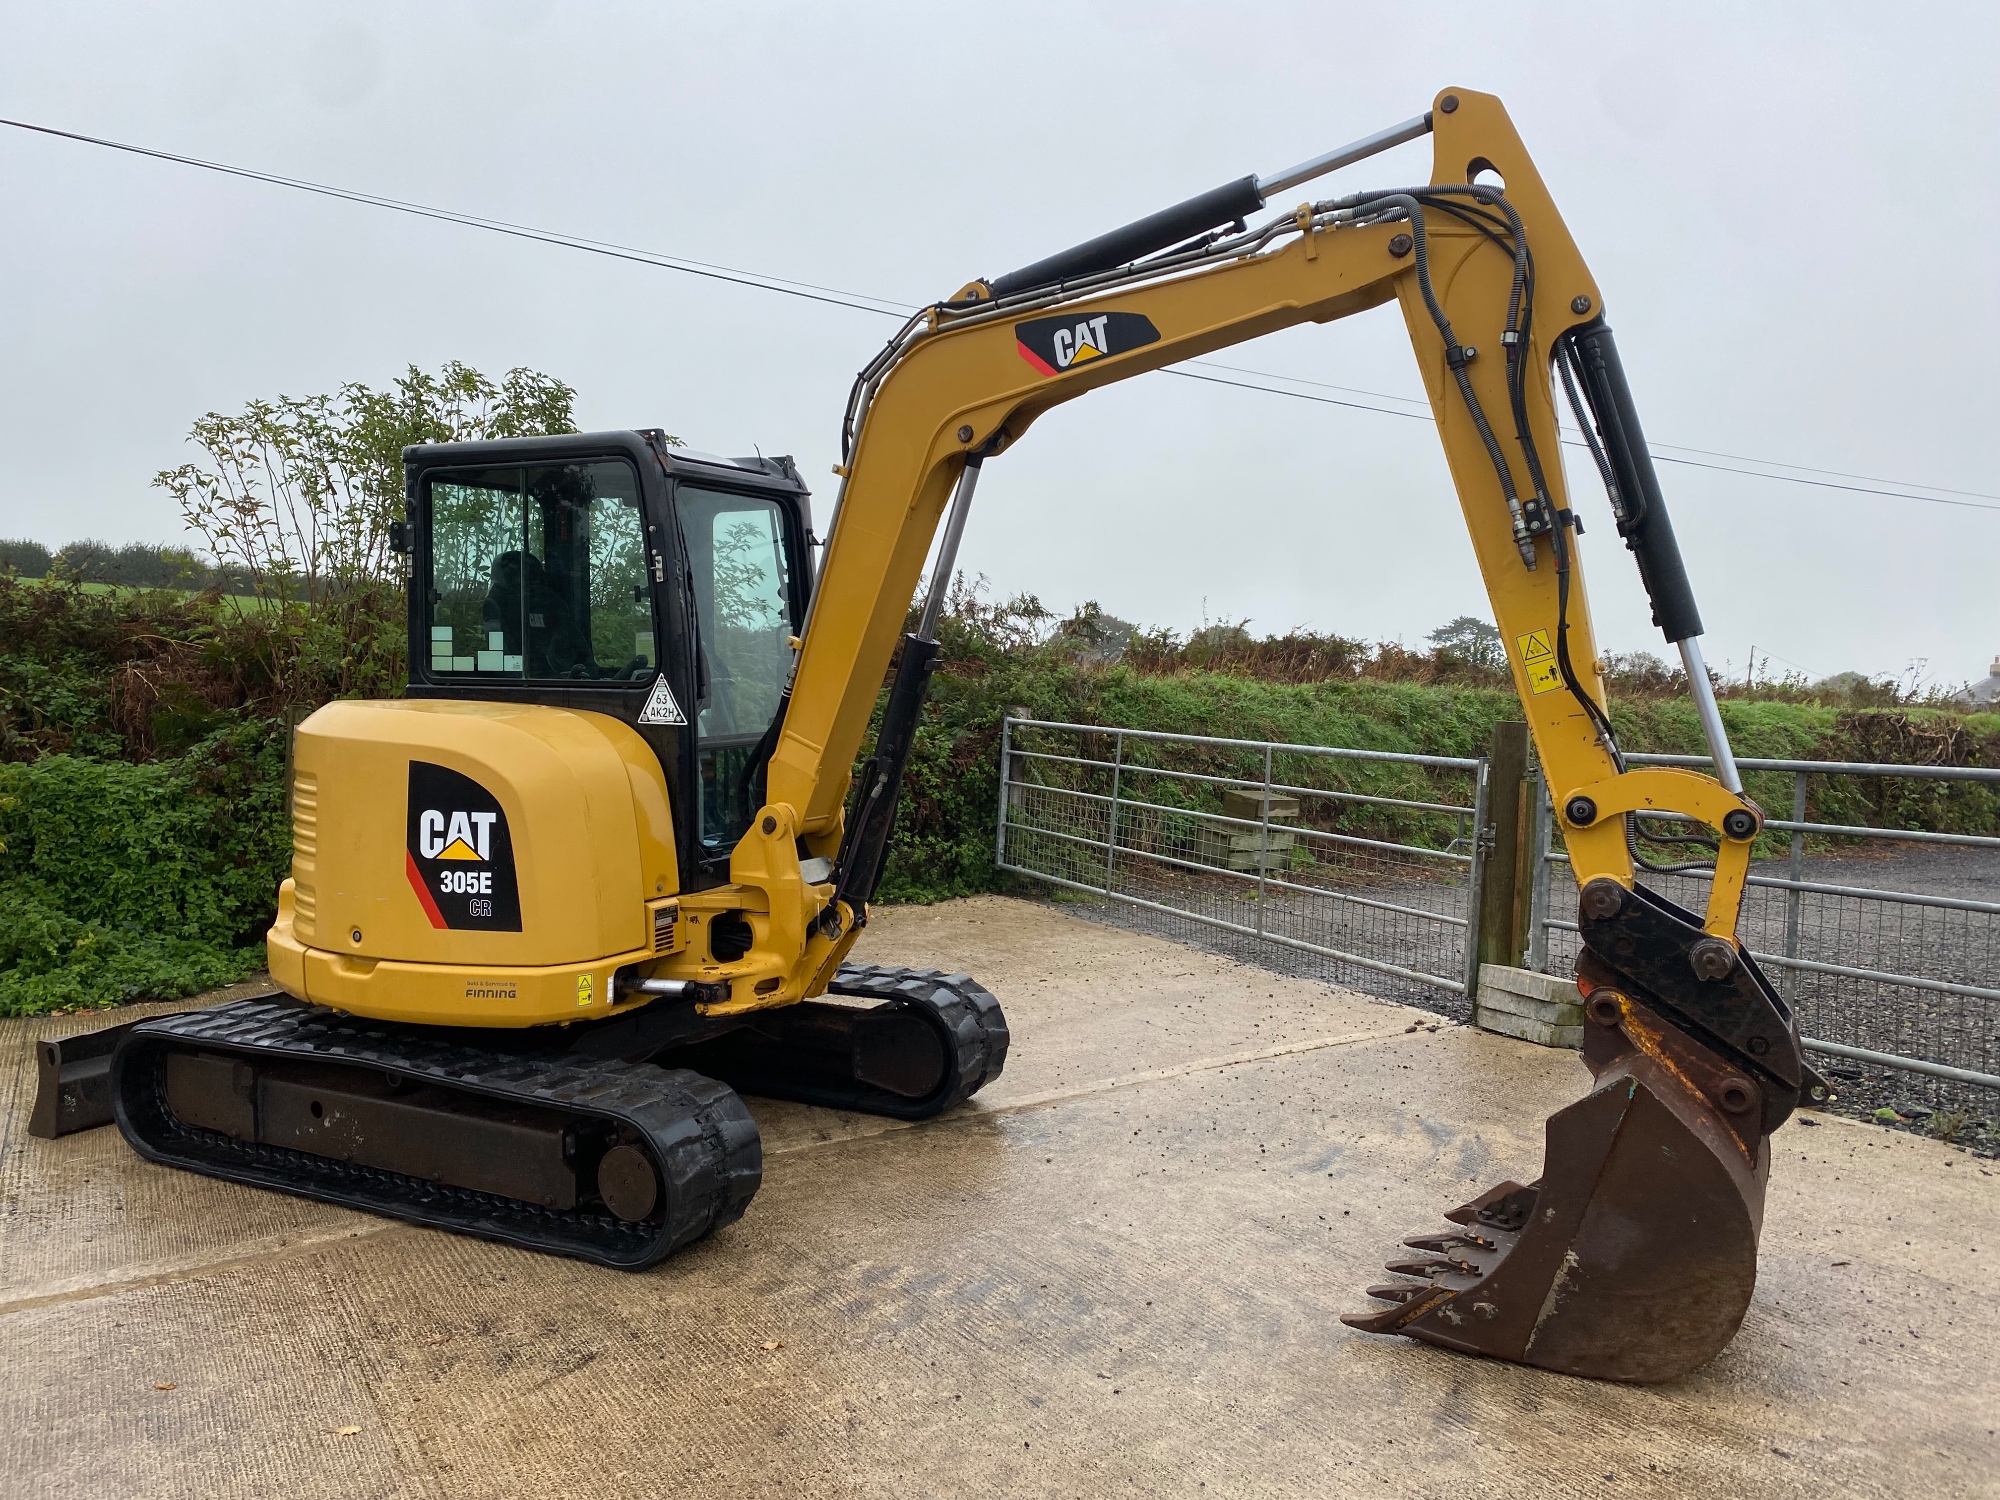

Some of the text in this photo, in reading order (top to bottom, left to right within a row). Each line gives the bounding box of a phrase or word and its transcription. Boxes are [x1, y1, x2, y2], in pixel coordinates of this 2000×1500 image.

[1053, 314, 1108, 368] CAT
[529, 613, 545, 628] CAT
[656, 694, 668, 705] 63
[650, 706, 675, 718] AK2H
[419, 809, 497, 861] CAT
[440, 870, 492, 894] 305E
[469, 898, 492, 917] CR
[466, 989, 516, 998] FINNING
